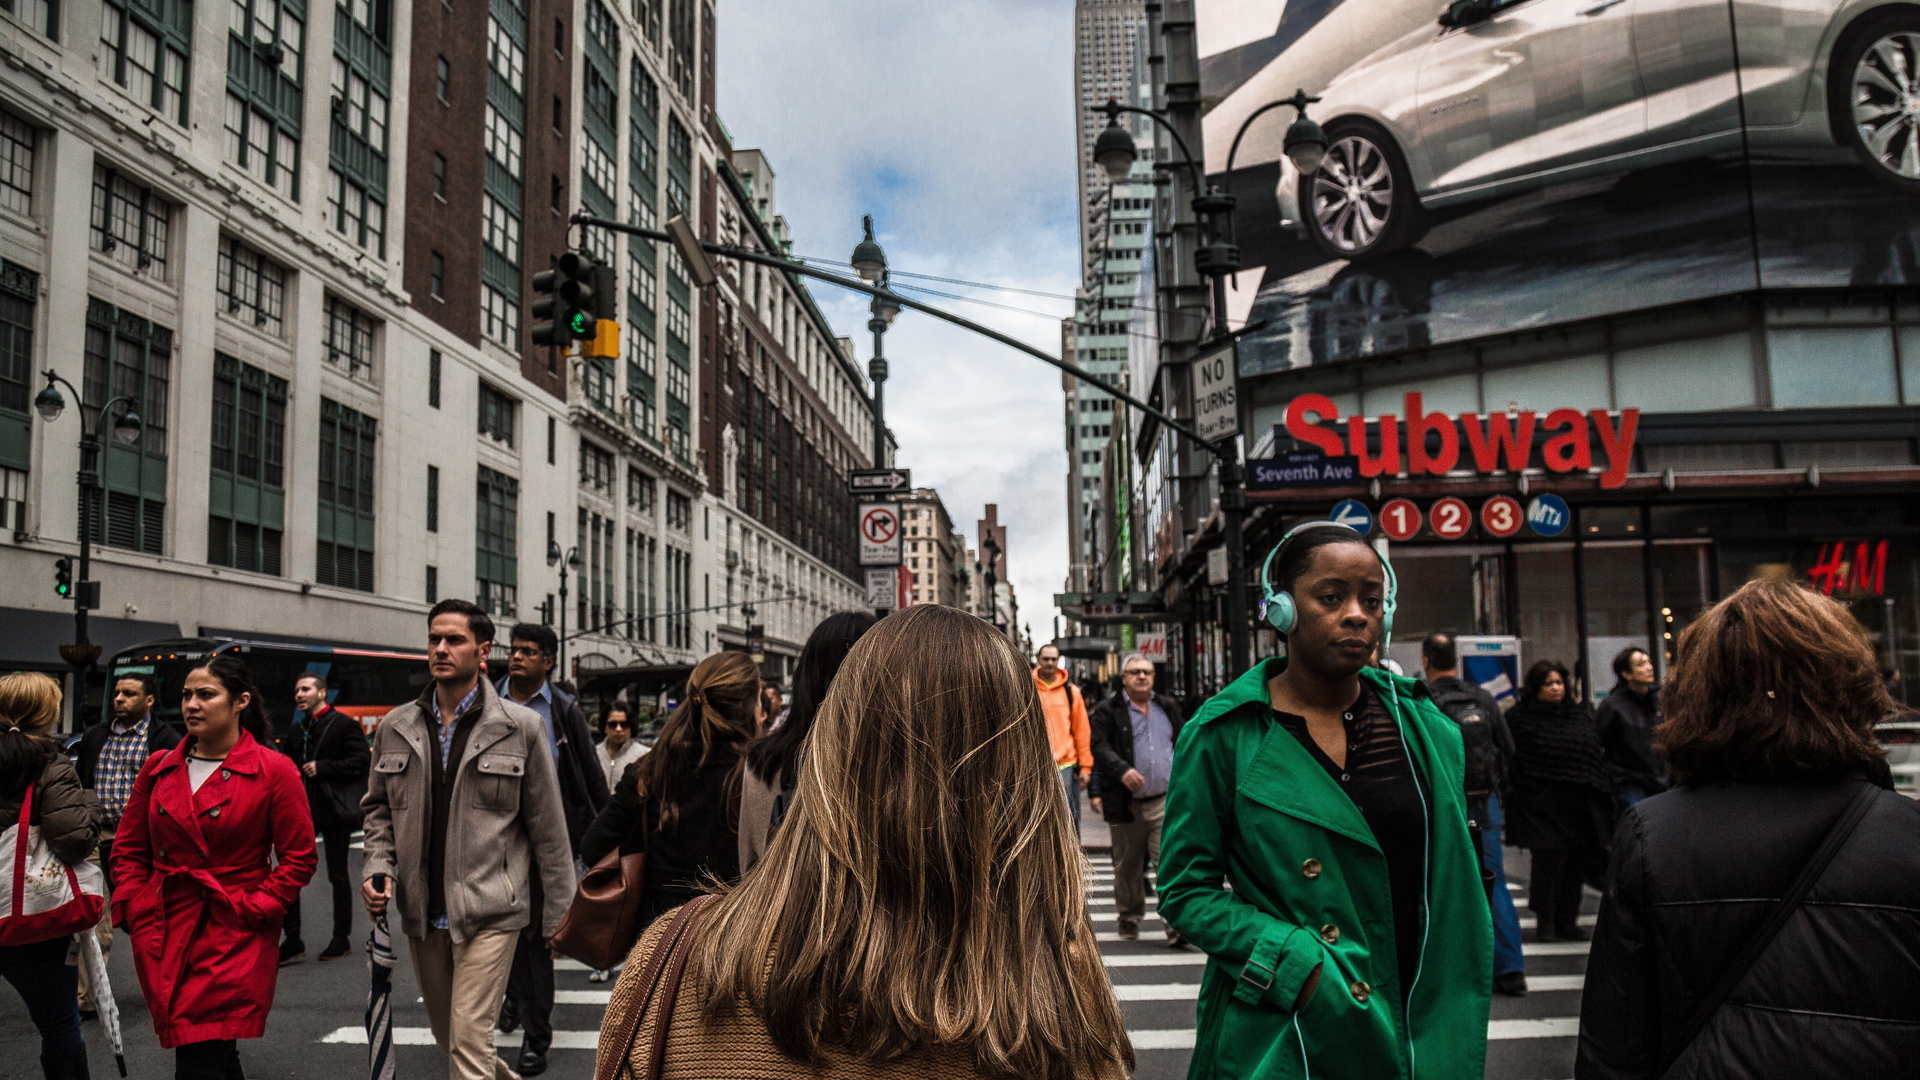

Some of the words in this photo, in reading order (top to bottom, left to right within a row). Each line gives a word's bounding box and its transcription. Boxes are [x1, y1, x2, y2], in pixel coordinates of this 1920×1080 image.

[1202, 358, 1225, 387] NO
[1194, 386, 1236, 416] TURNS
[1285, 391, 1640, 489] Subway
[857, 477, 874, 486] ONE
[882, 476, 900, 485] WAY
[1256, 464, 1319, 482] Seventh
[1323, 463, 1353, 480] Ave
[1391, 505, 1407, 534] 1
[1440, 503, 1462, 533] 2
[1491, 502, 1513, 531] 3
